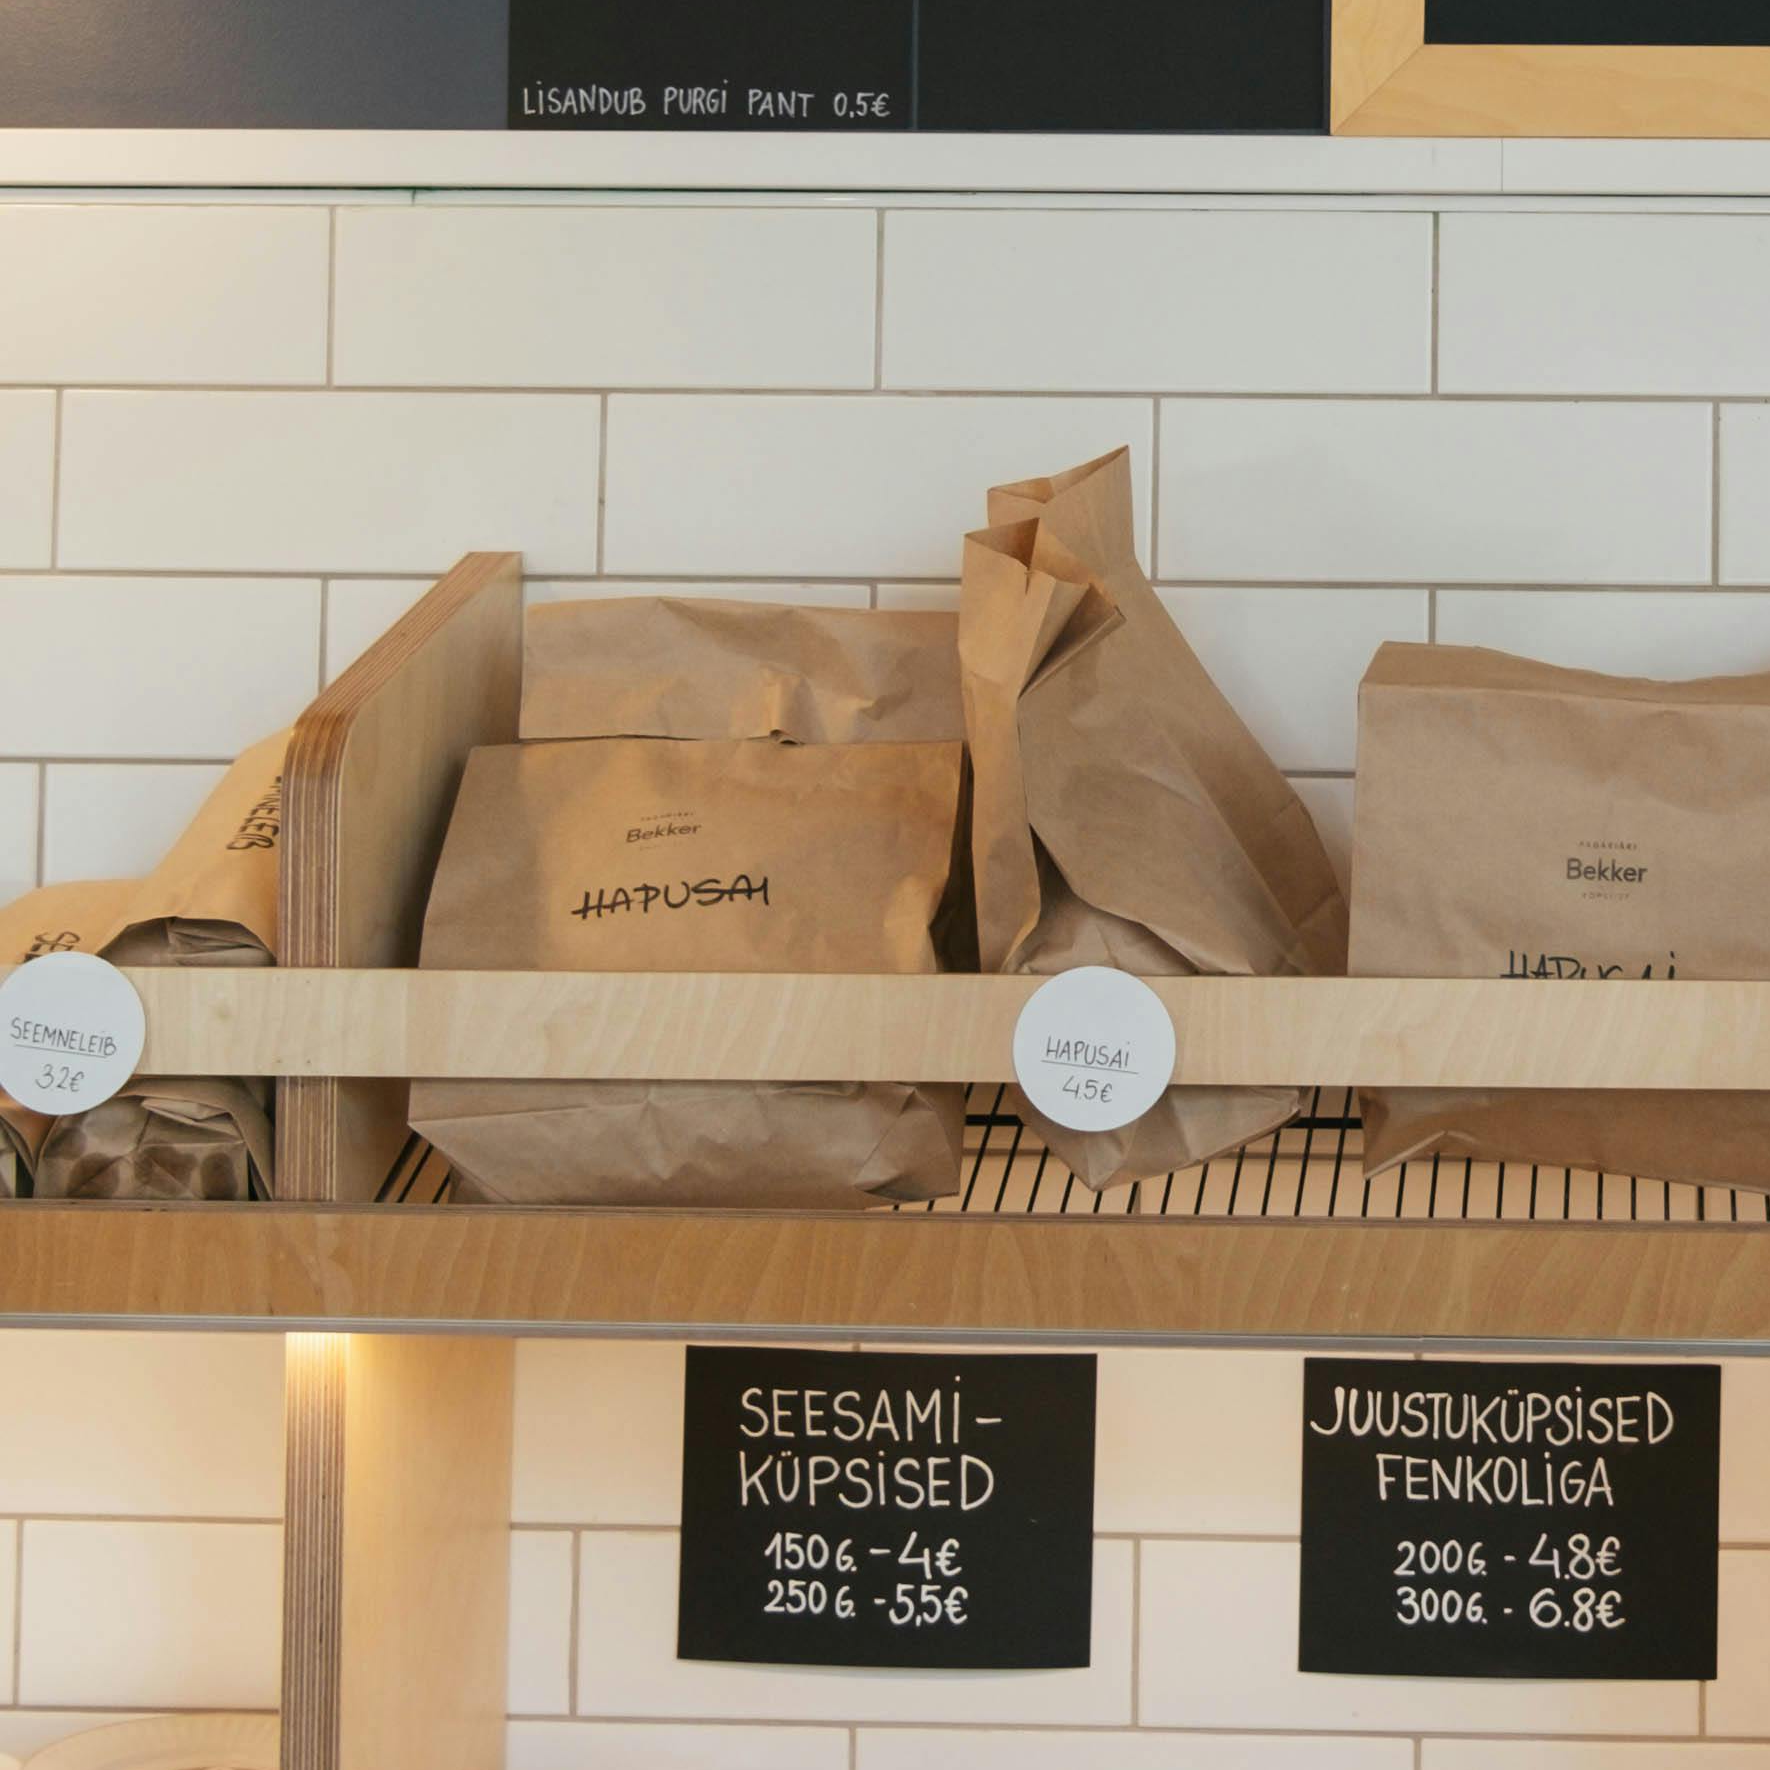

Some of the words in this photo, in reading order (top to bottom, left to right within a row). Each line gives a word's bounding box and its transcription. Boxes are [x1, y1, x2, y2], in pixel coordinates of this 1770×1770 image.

[524, 82, 646, 116] LISANDUB
[664, 80, 728, 115] PURGI
[749, 91, 815, 116] PANT
[833, 93, 890, 118] 0.5€
[626, 823, 702, 843] Bekker
[1566, 857, 1648, 883] Bekker
[571, 874, 769, 920] HAPUSAI
[11, 1017, 117, 1056] SEEMNELEIB
[1046, 1036, 1130, 1068] HAPUSAI
[1310, 1386, 1674, 1446] JUUSTUKÜPSISED
[739, 1450, 995, 1510] KÜPSISED
[1376, 1452, 1614, 1506] FENKOLIGA
[1529, 1533, 1622, 1580] 4.8€
[1529, 1588, 1625, 1631] 6.8€
